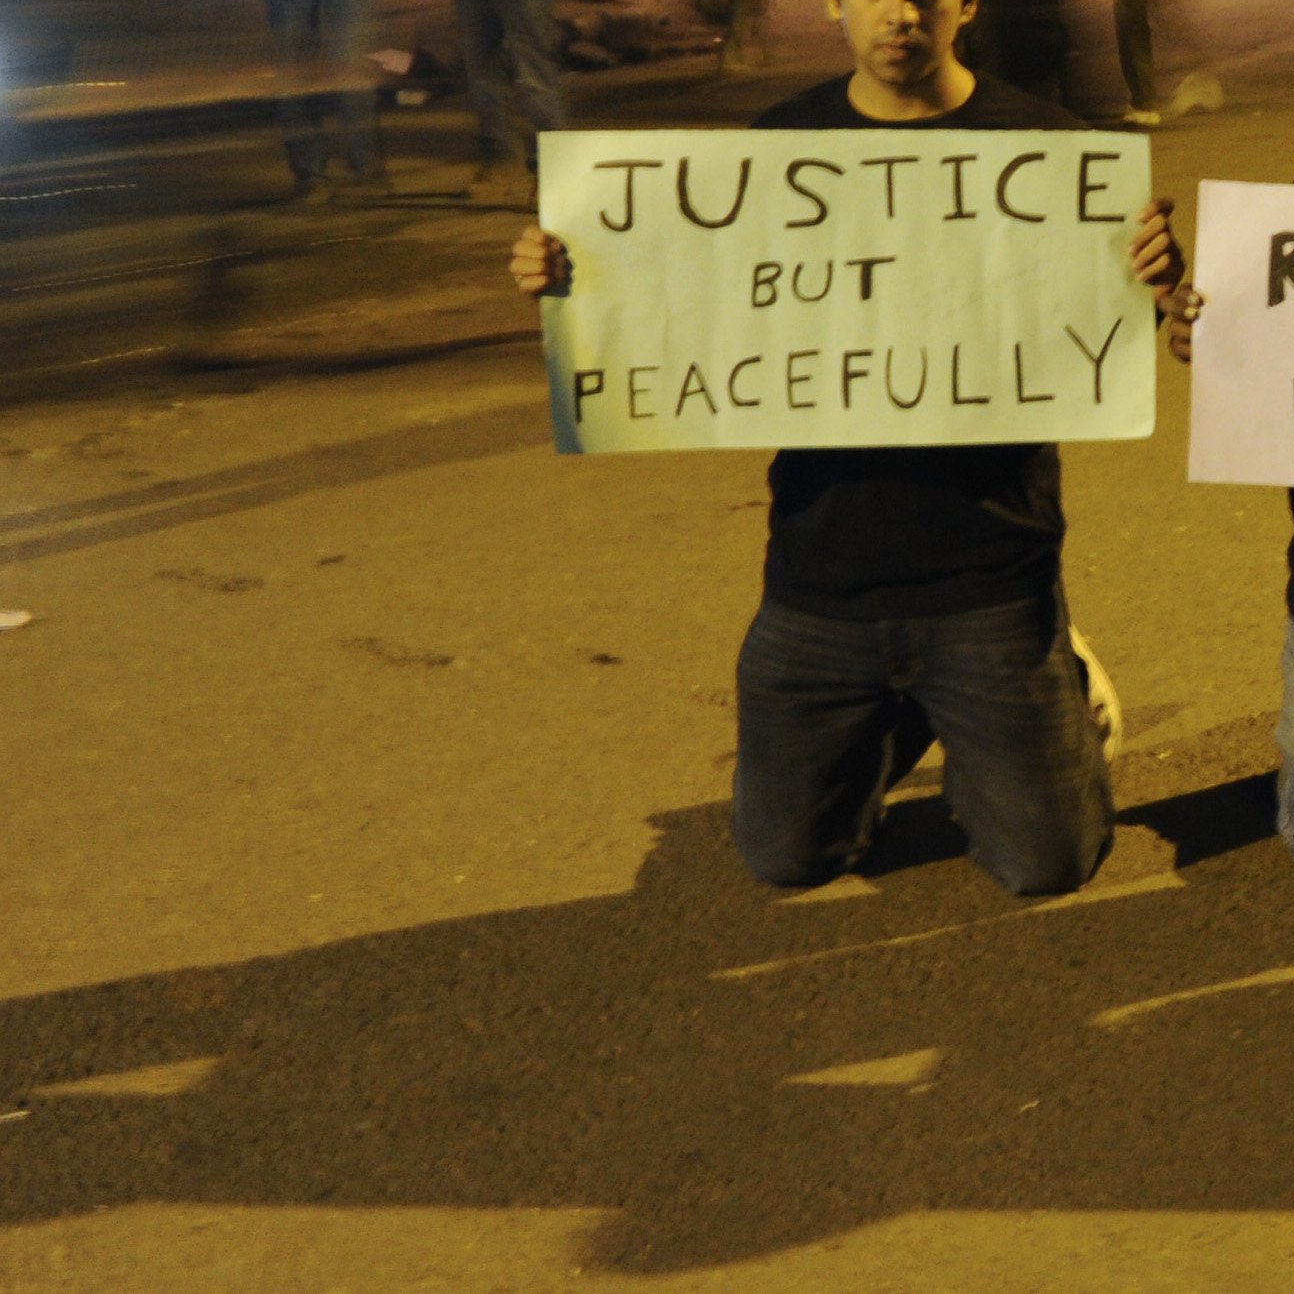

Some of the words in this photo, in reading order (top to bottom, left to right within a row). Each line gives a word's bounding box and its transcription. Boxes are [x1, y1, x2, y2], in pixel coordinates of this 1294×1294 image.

[594, 151, 1127, 232] JUSTICE
[751, 255, 897, 307] BUT
[574, 316, 1124, 423] PEACEFULLY
